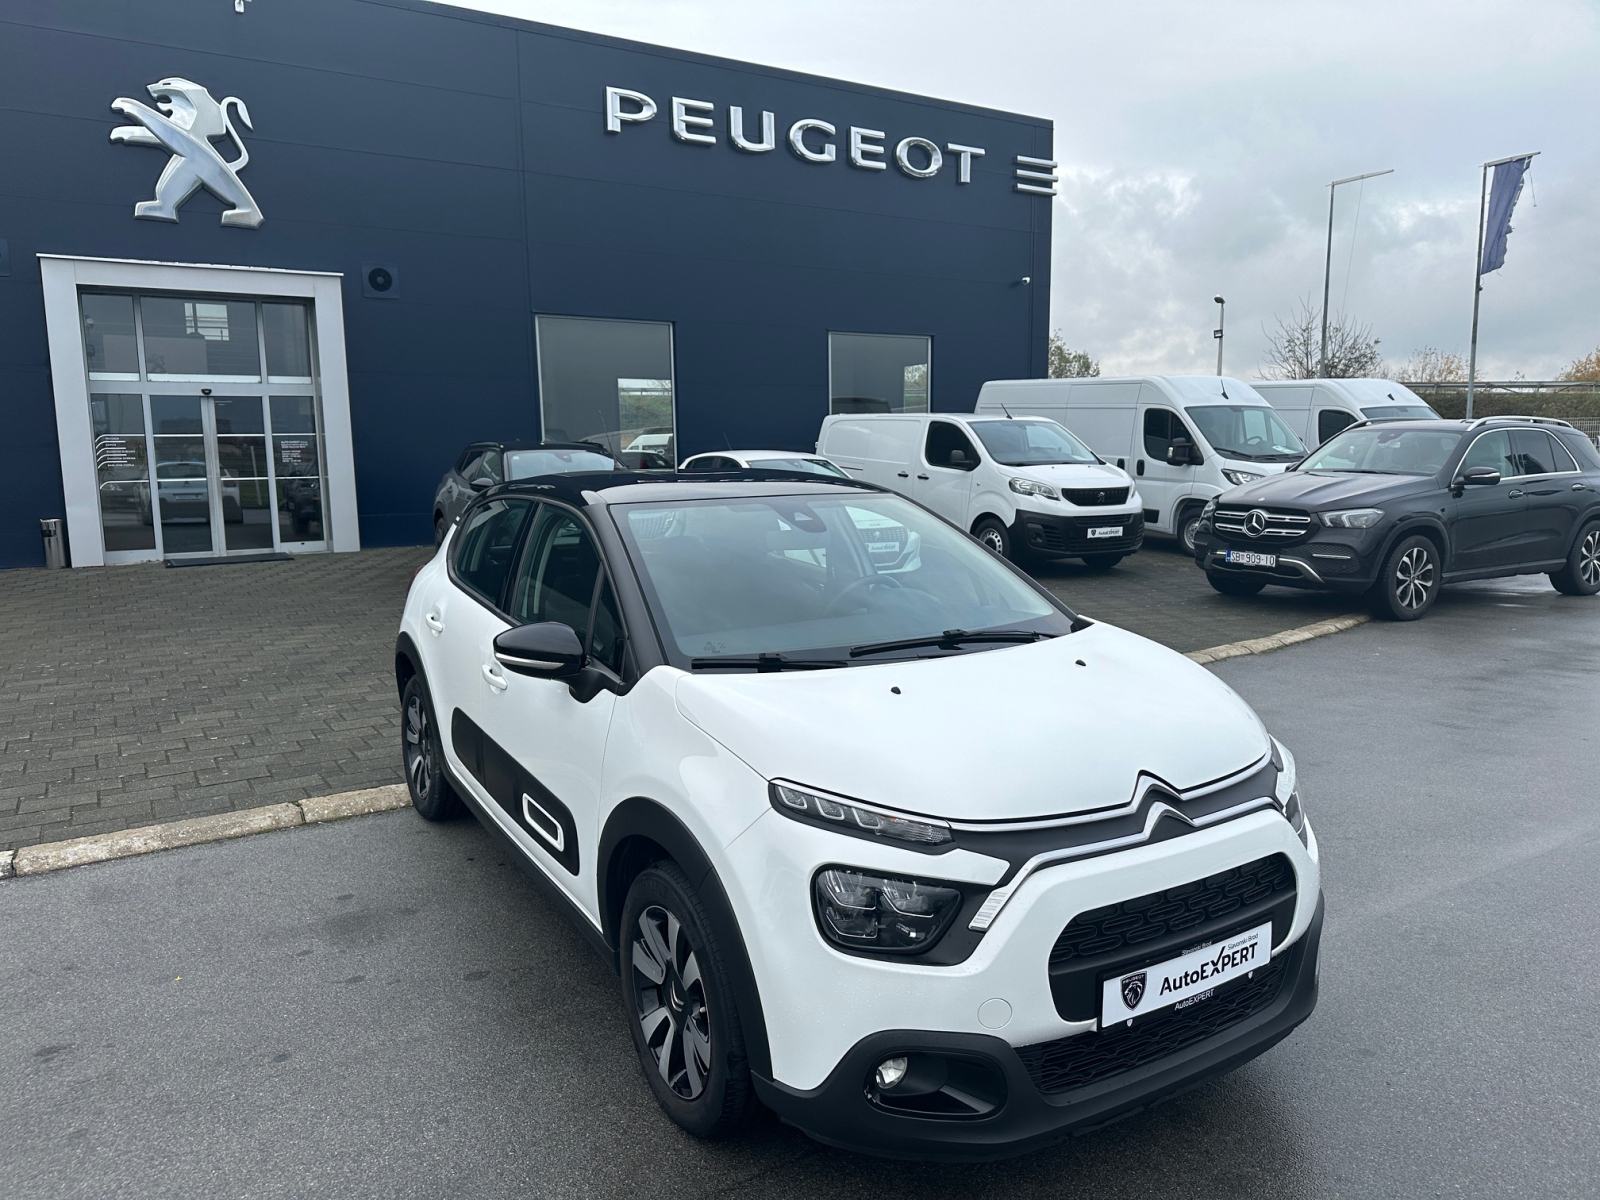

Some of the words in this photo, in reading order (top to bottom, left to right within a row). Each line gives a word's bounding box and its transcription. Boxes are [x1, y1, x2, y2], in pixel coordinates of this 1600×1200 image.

[605, 86, 985, 184] PEUGEOT
[1248, 932, 1259, 942] Brod
[1160, 942, 1258, 996] AutoEXPERT
[1174, 988, 1215, 1011] AutoEXPERT
